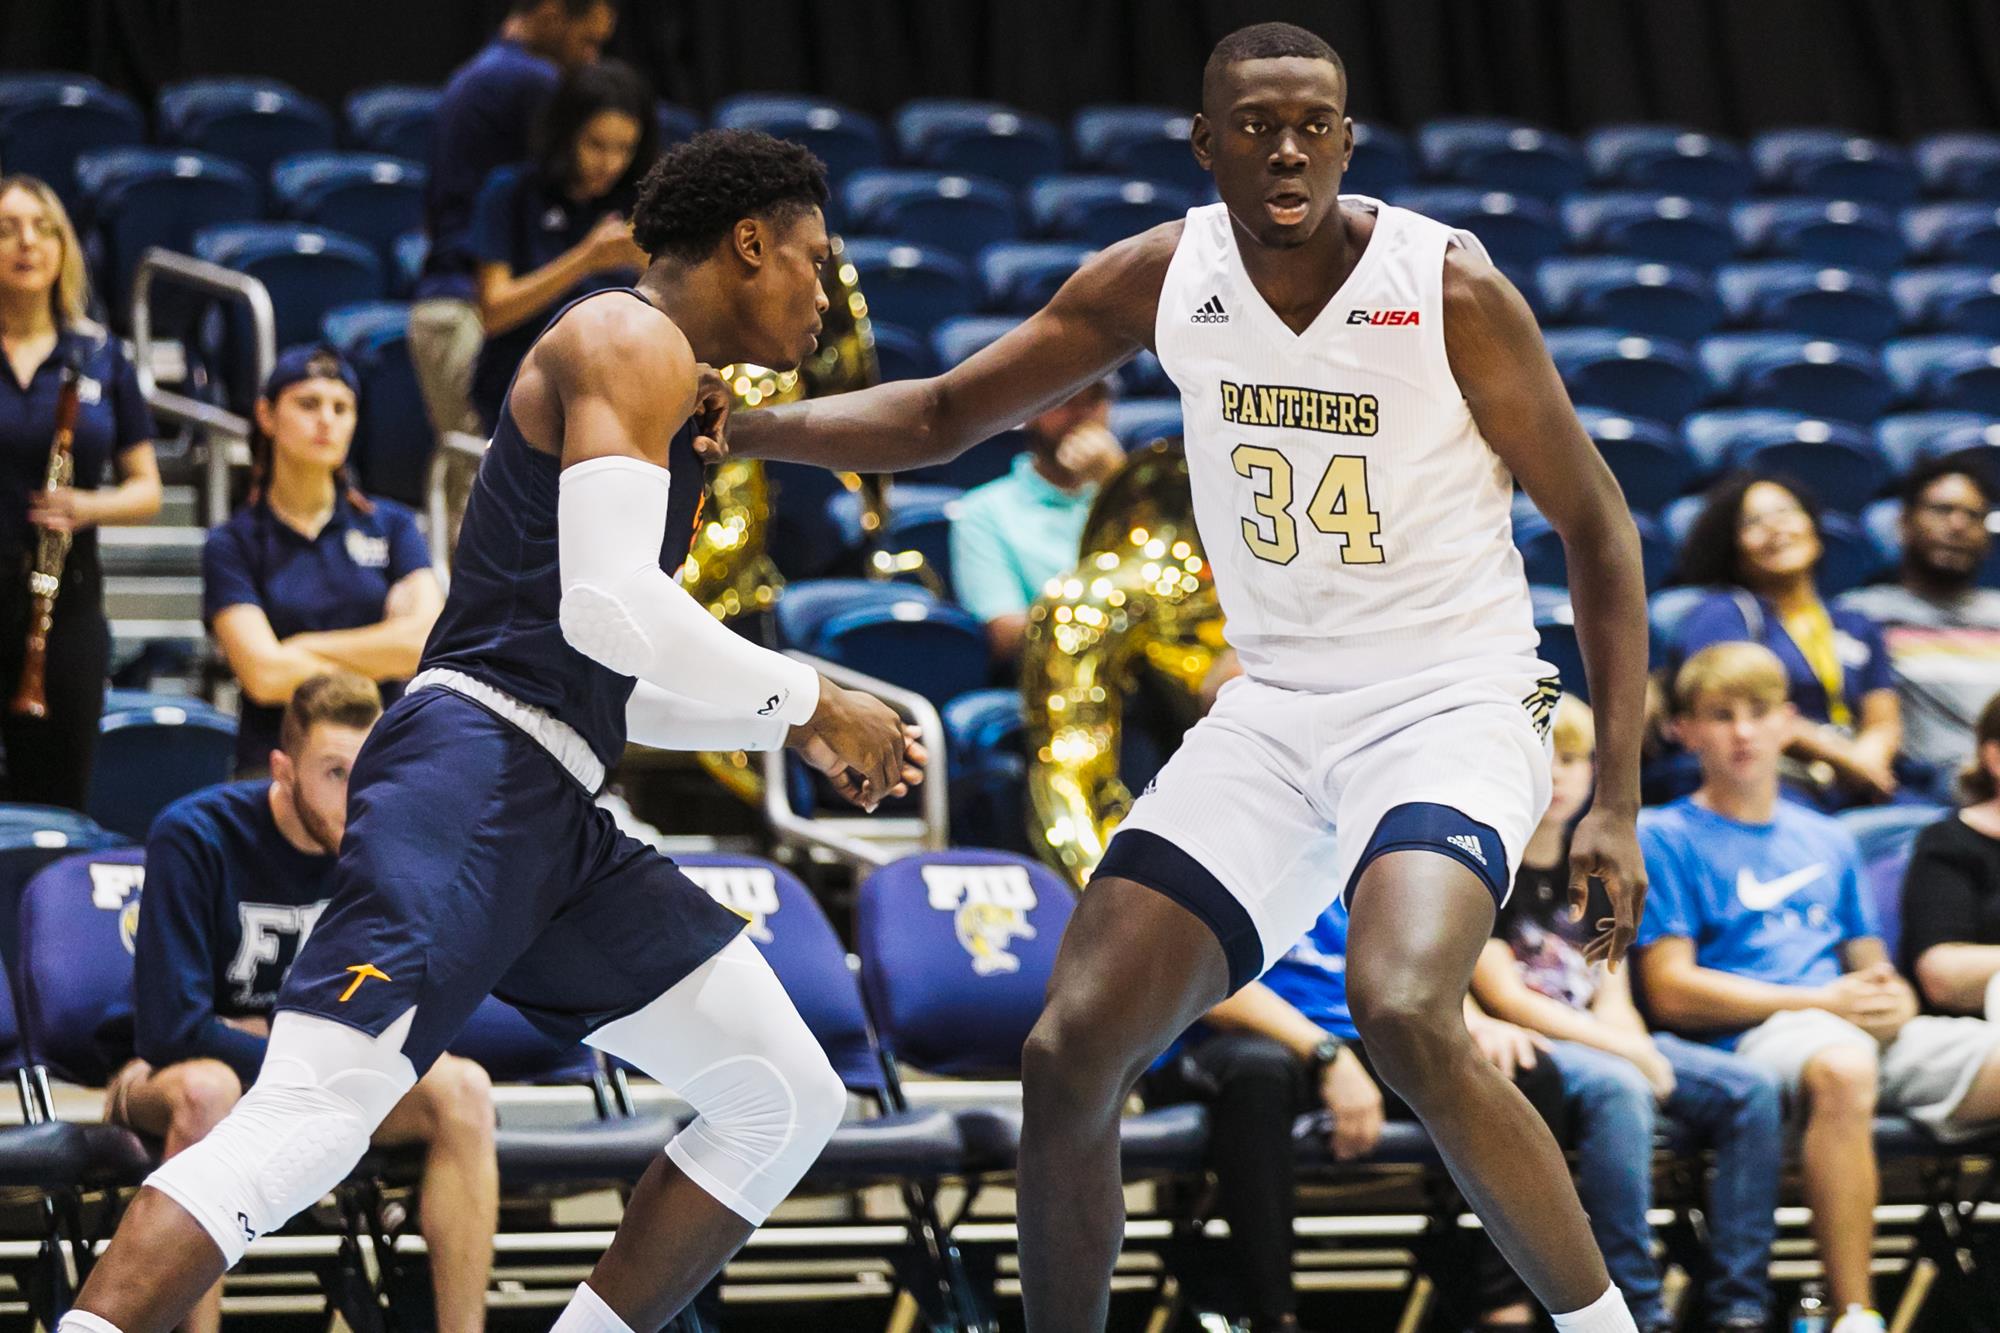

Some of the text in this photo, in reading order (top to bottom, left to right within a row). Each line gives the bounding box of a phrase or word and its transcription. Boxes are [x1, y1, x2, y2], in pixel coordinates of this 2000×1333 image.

[1190, 311, 1230, 323] adidas
[1220, 380, 1379, 437] PANTHERS
[1230, 443, 1386, 567] 34
